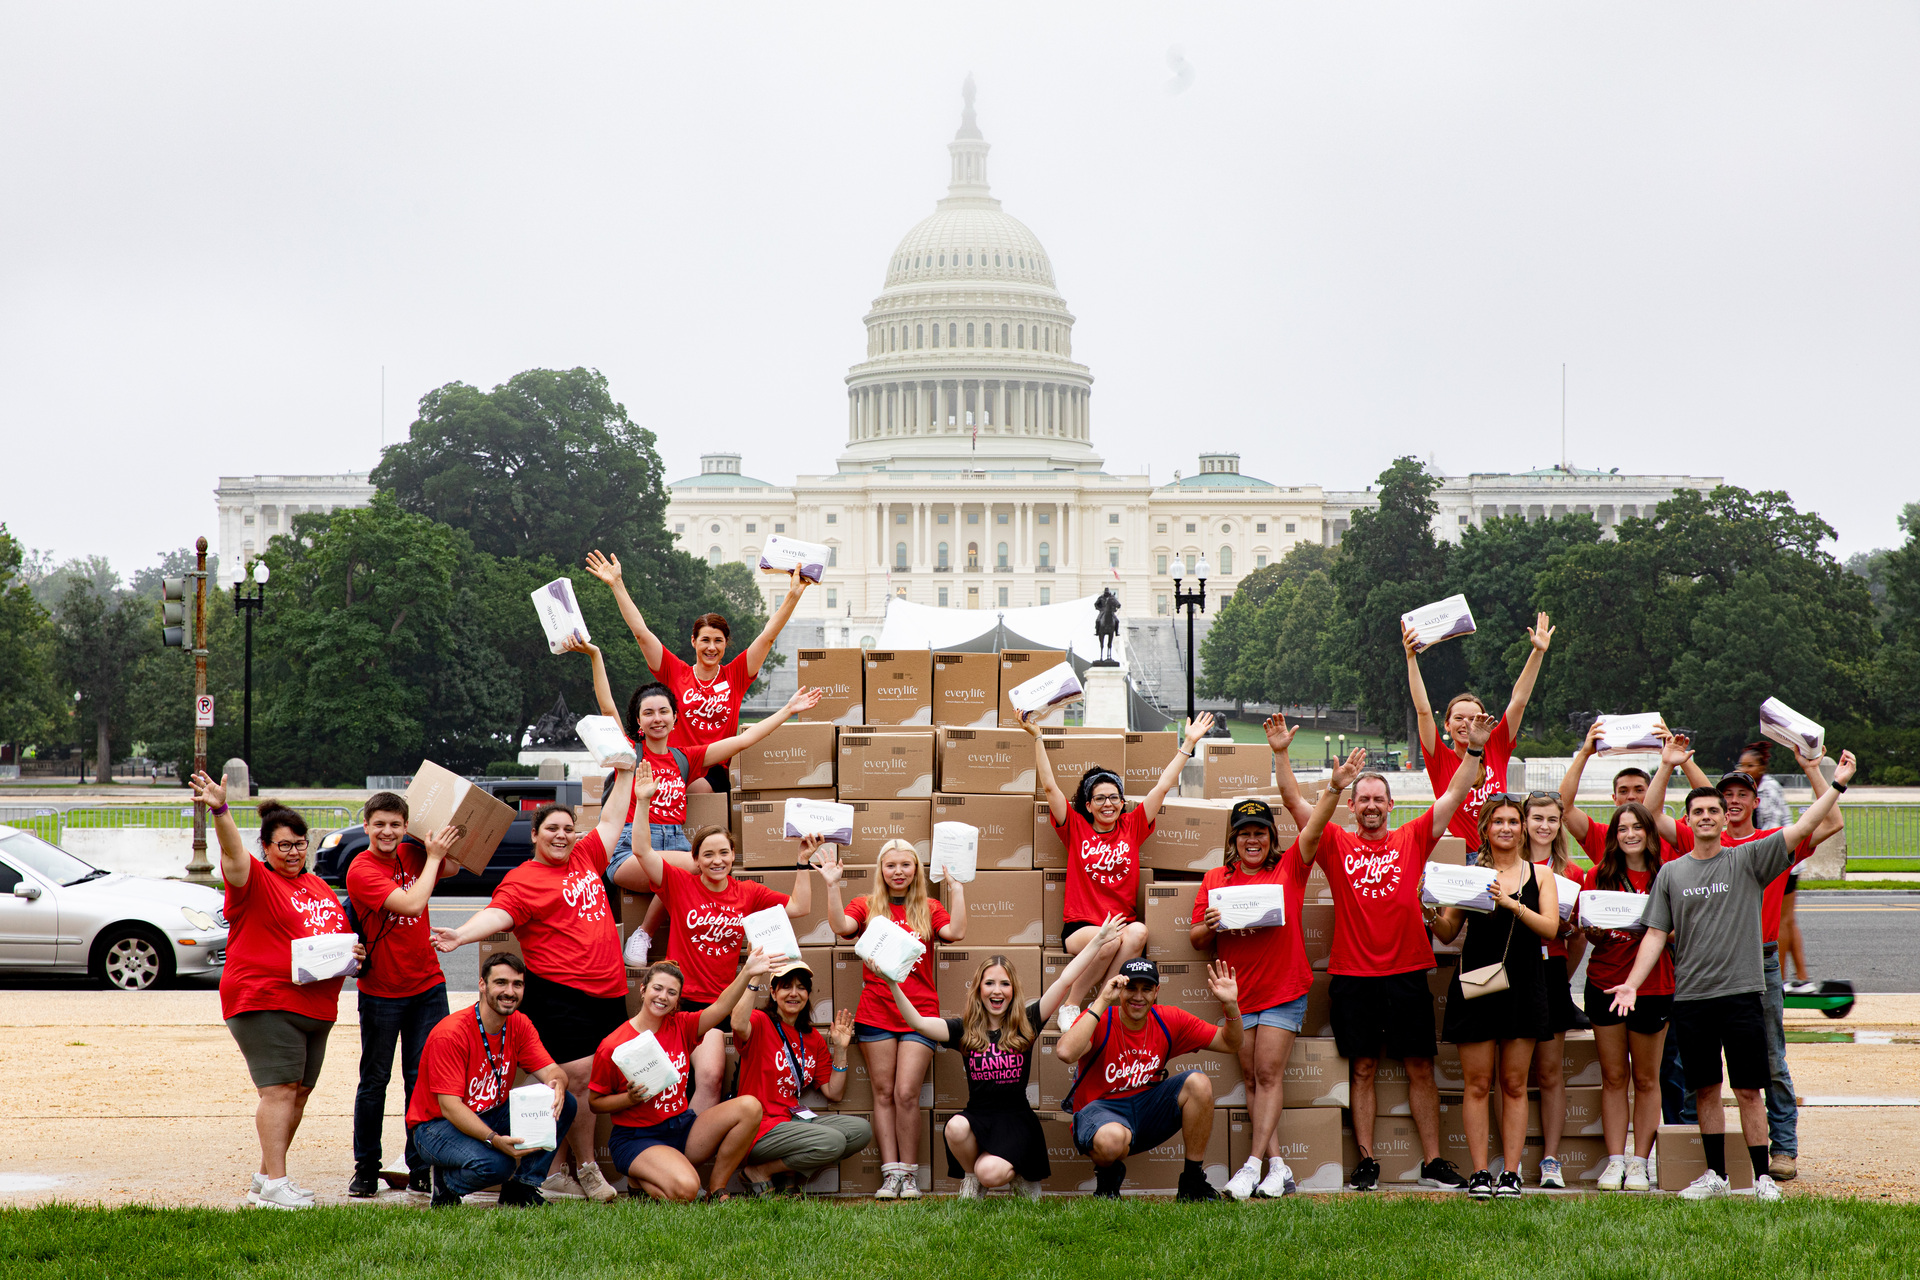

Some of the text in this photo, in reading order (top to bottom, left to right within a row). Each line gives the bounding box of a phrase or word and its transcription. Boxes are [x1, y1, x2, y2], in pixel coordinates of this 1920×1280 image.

[782, 549, 807, 559] everylife
[1424, 612, 1450, 626] everylife
[877, 685, 919, 698] everylife
[944, 688, 986, 700] everylife
[1030, 679, 1054, 695] everylife
[1615, 723, 1642, 733] everylife
[763, 747, 807, 761] everylife
[968, 753, 1012, 766] everylife
[863, 758, 907, 772] everylife
[1218, 774, 1259, 787] everylife
[414, 780, 441, 822] everylife
[809, 813, 835, 823] everylife
[861, 824, 905, 837] everylife
[978, 824, 1005, 838] rylife
[1156, 828, 1201, 842] everylife
[1091, 852, 1129, 871] Life
[1344, 848, 1400, 875] Celebrate
[1084, 858, 1131, 884] WEEKEND
[1360, 863, 1395, 884] Life
[562, 869, 599, 907] Celebrate
[1353, 866, 1402, 898] WEEKEND
[1447, 878, 1476, 887] everylife
[580, 883, 602, 911] Life
[1682, 882, 1730, 898] everylife
[970, 901, 1015, 914] everylife
[1231, 901, 1260, 910] everylife
[1604, 905, 1632, 914] everylife
[686, 909, 744, 930] Celebrat
[700, 924, 738, 943] Life
[754, 923, 781, 939] everylife
[870, 931, 889, 957] everylife
[632, 1059, 659, 1078] everylife
[969, 1053, 1024, 1072] PLANNED
[1105, 1054, 1161, 1083] Celebrate
[971, 1067, 1022, 1081] PARENTHOOD
[521, 1110, 550, 1120] everylife
